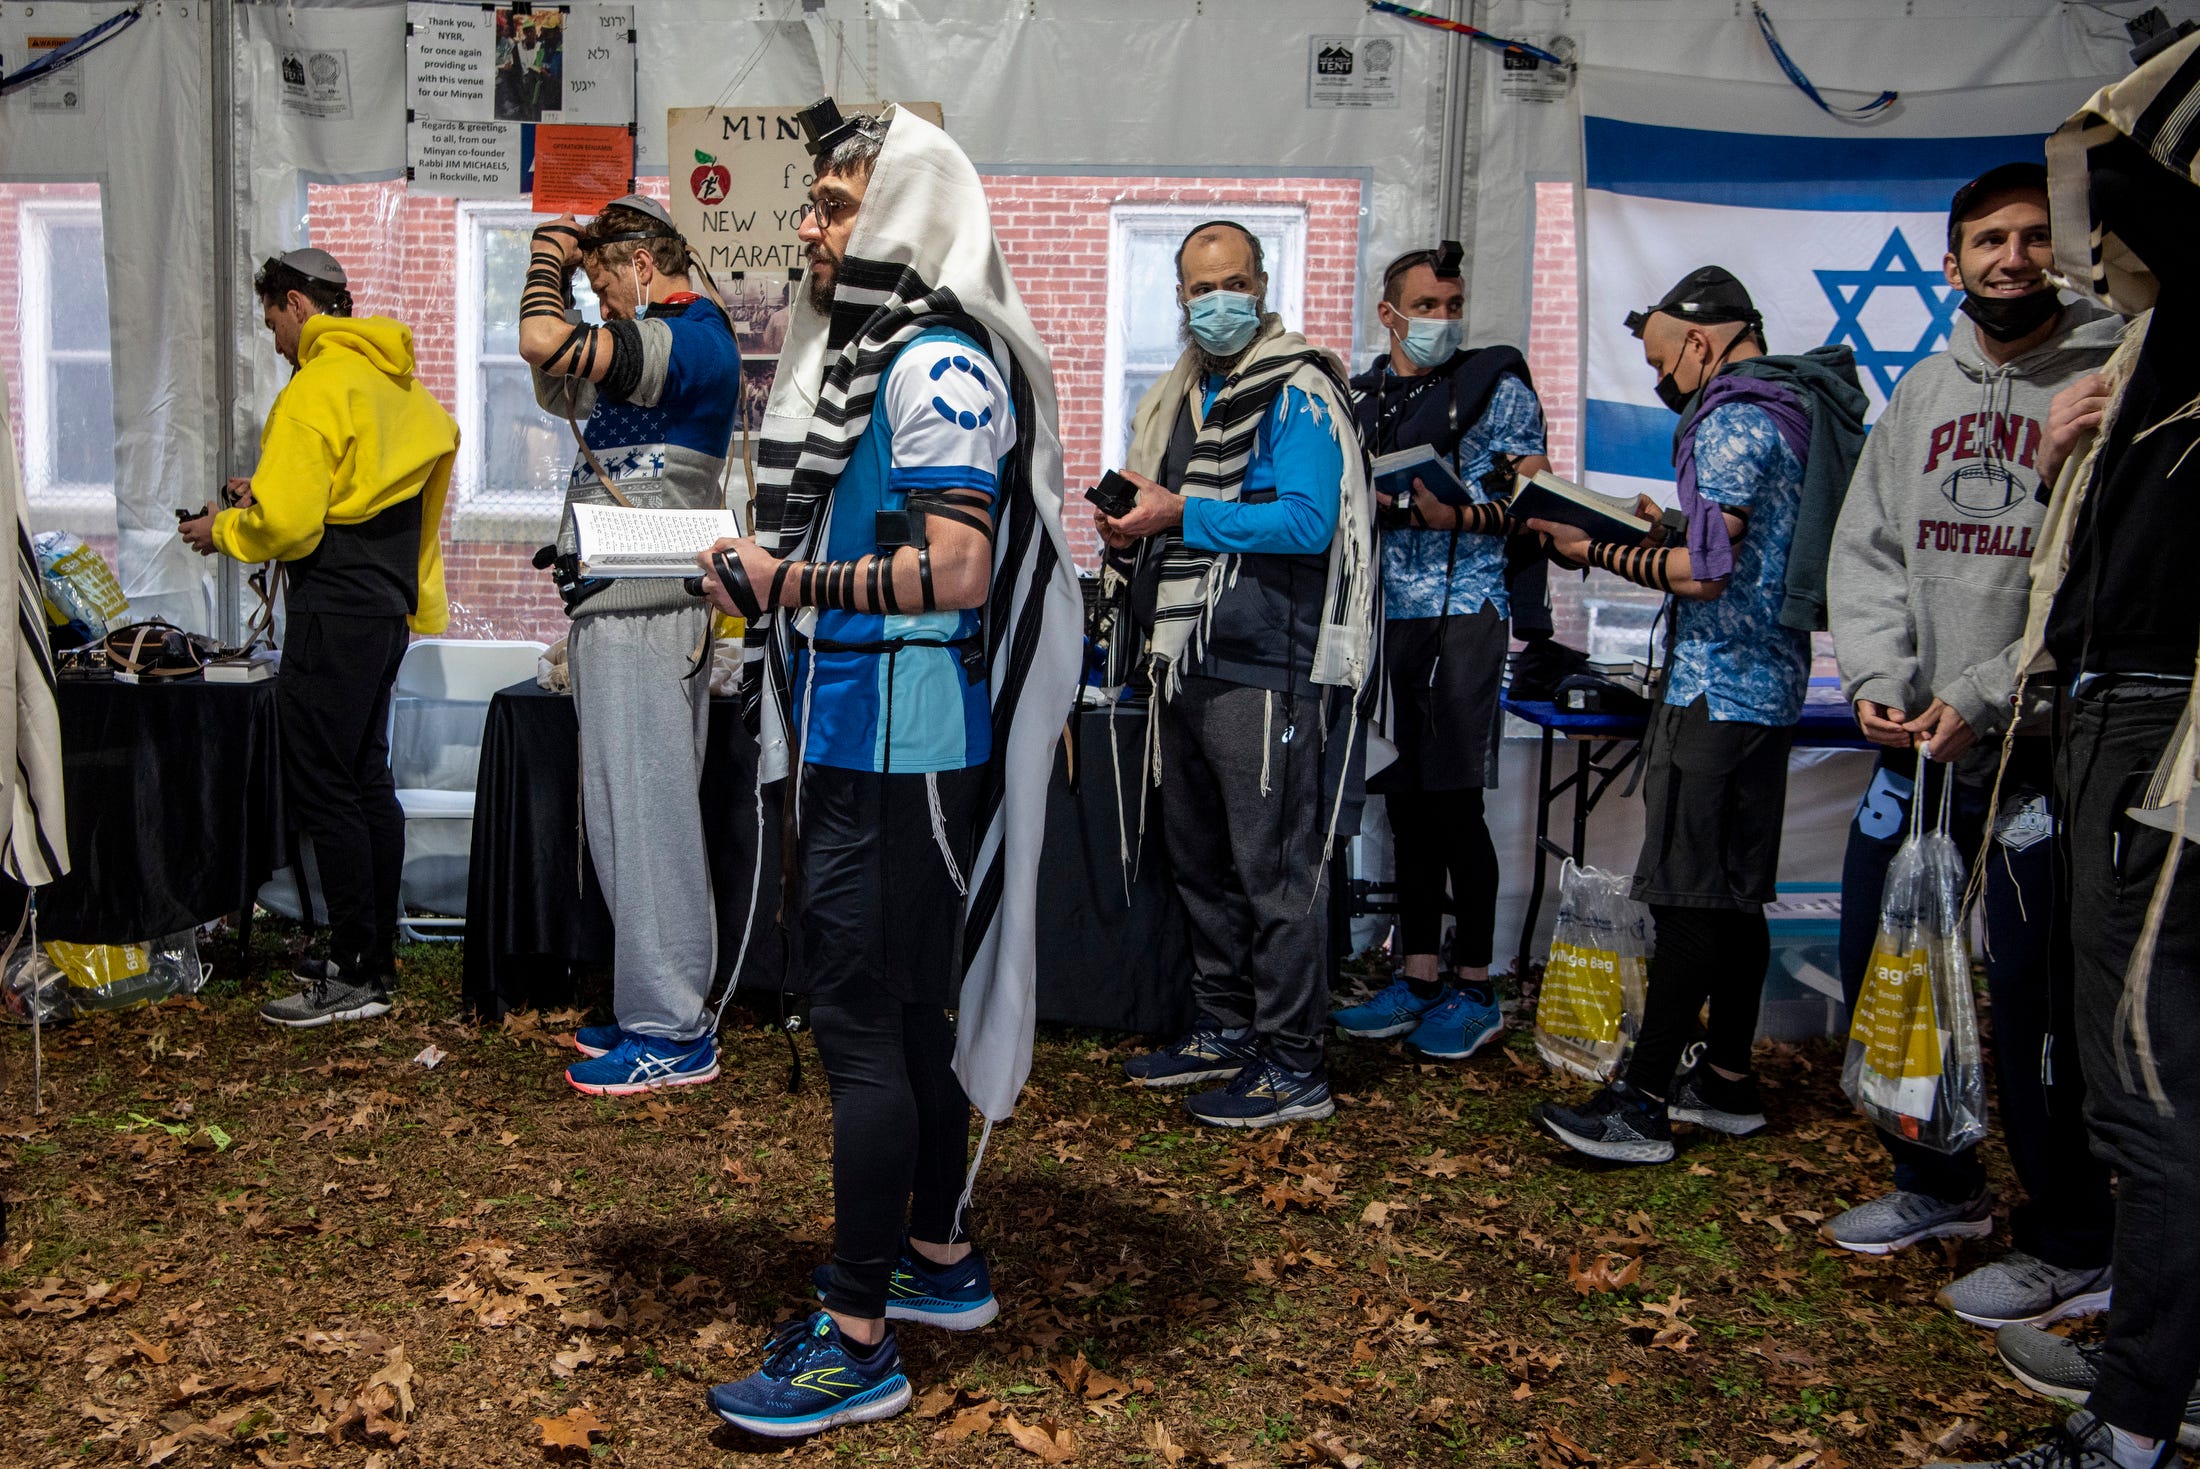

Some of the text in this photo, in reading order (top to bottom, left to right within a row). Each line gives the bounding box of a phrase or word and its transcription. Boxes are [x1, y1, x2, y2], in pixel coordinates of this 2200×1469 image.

[428, 17, 476, 29] Thank you,
[438, 31, 465, 42] NYRR,
[420, 45, 482, 58] for once again
[587, 46, 610, 60] ולא
[424, 61, 466, 72] providing
[1319, 61, 1352, 71] TENT
[417, 74, 437, 83] with
[439, 75, 455, 84] this
[418, 88, 431, 97] for
[450, 89, 483, 100] Minyan
[421, 121, 508, 134] Regards & greetings
[722, 115, 801, 141] MIN
[432, 135, 441, 143] to
[443, 134, 457, 144] all,
[458, 135, 479, 144] from
[423, 147, 506, 158] Minyan co-founder
[419, 159, 510, 172] Rabbi JIM MICHAELS,
[429, 172, 499, 183] in Rockville, MD
[783, 163, 813, 189] fo
[702, 209, 803, 233] NEW YO
[710, 244, 806, 268] MARATH
[1922, 411, 2042, 475] PENN
[1916, 519, 2036, 558] FOOTBALL
[1858, 767, 1915, 840] 5
[1590, 956, 1615, 974] Bag
